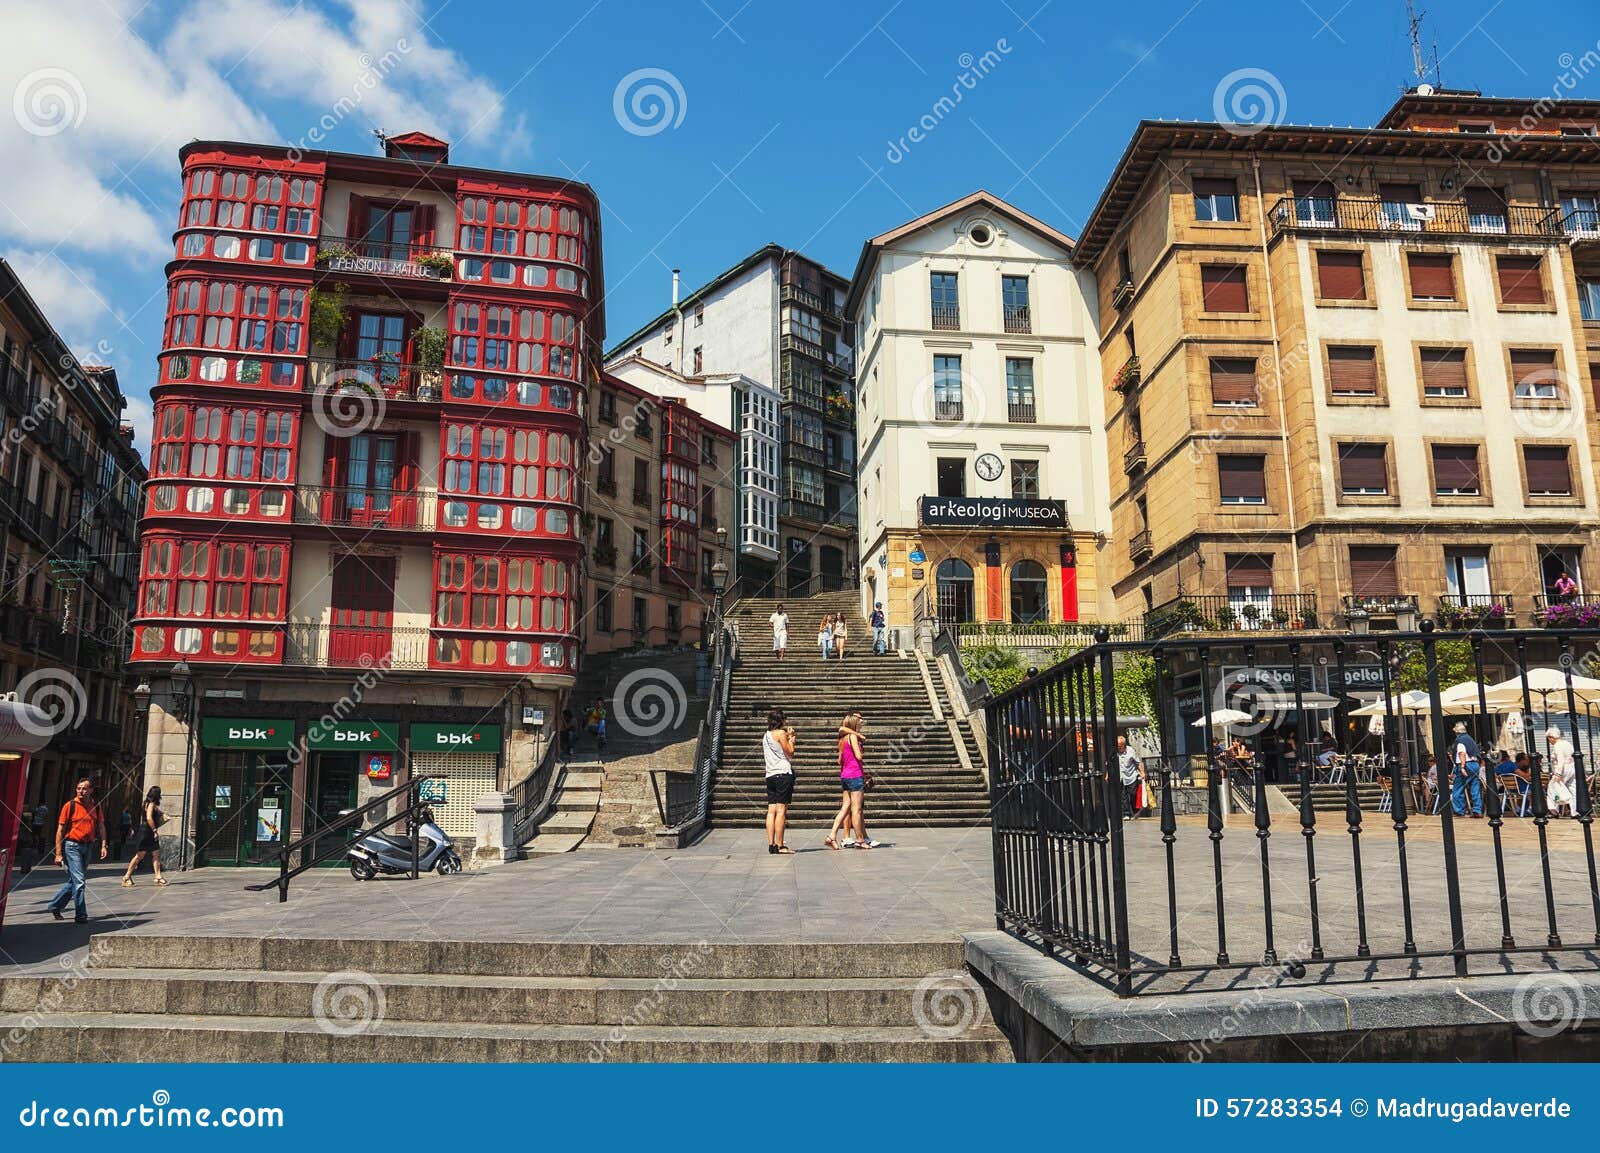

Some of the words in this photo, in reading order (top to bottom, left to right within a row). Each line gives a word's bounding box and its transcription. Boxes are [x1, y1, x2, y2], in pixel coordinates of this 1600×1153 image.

[929, 500, 1006, 521] arkeologi
[1008, 506, 1060, 519] MUSEOA
[228, 727, 267, 740] bbk
[334, 730, 372, 742] bbk
[436, 732, 473, 744] bbk
